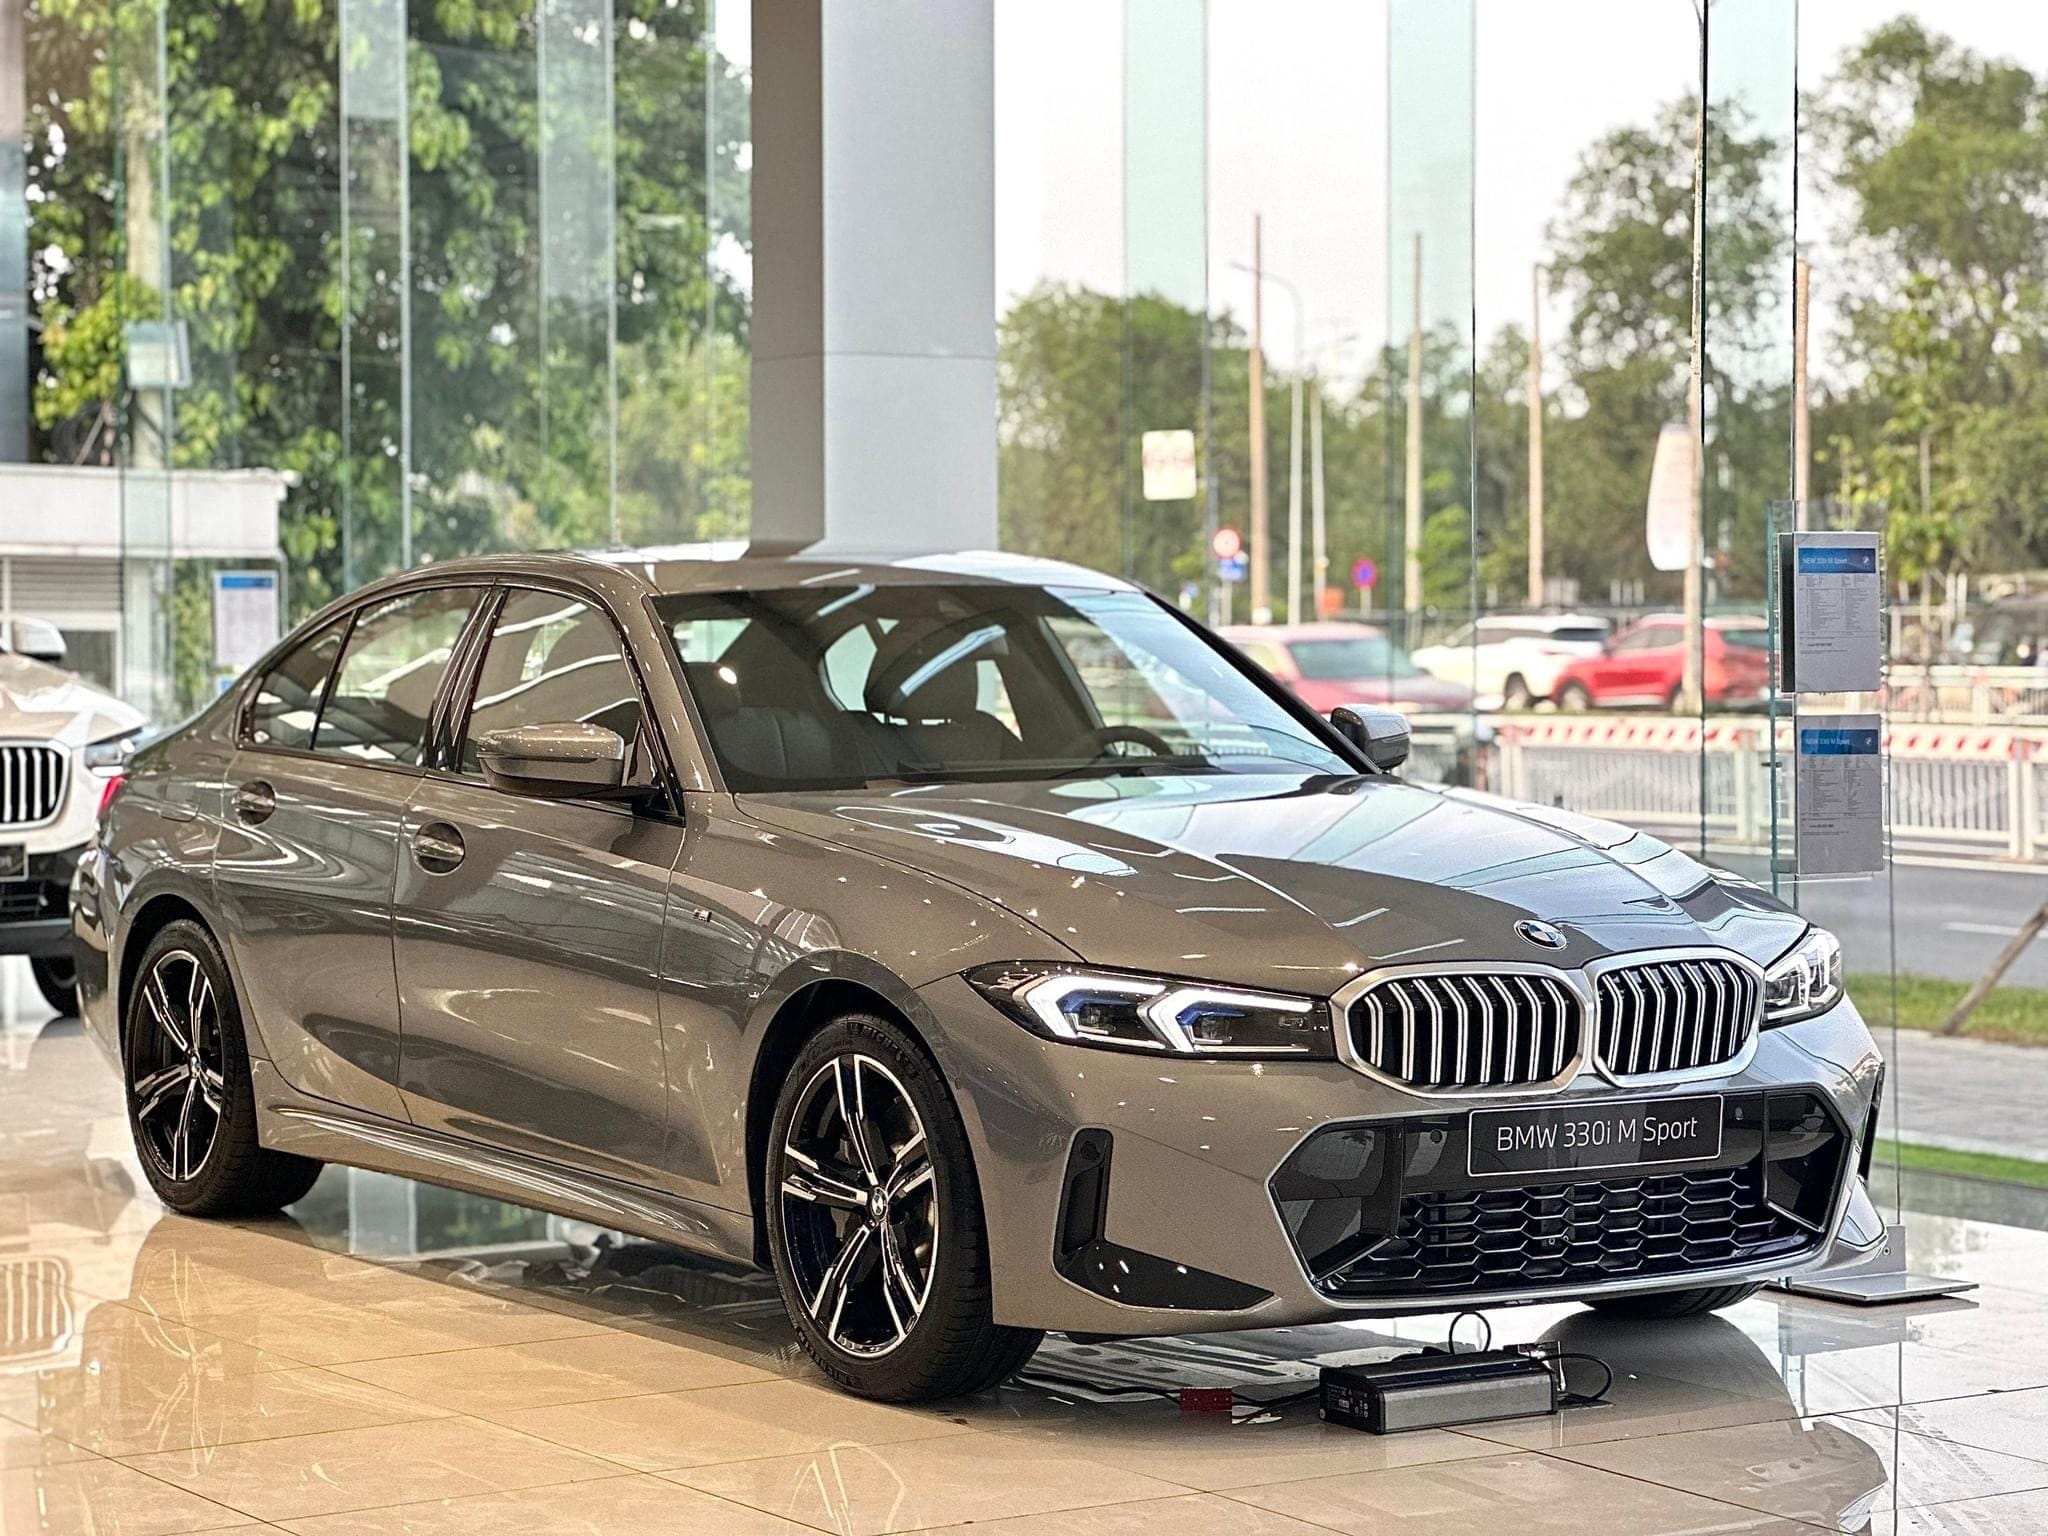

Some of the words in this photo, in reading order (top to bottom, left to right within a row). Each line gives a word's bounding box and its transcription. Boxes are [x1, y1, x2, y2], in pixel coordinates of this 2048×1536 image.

[1497, 1123, 1558, 1152] BMW
[1563, 1120, 1611, 1148] 330i
[1617, 1118, 1637, 1144] M
[1642, 1116, 1699, 1146] Sport
